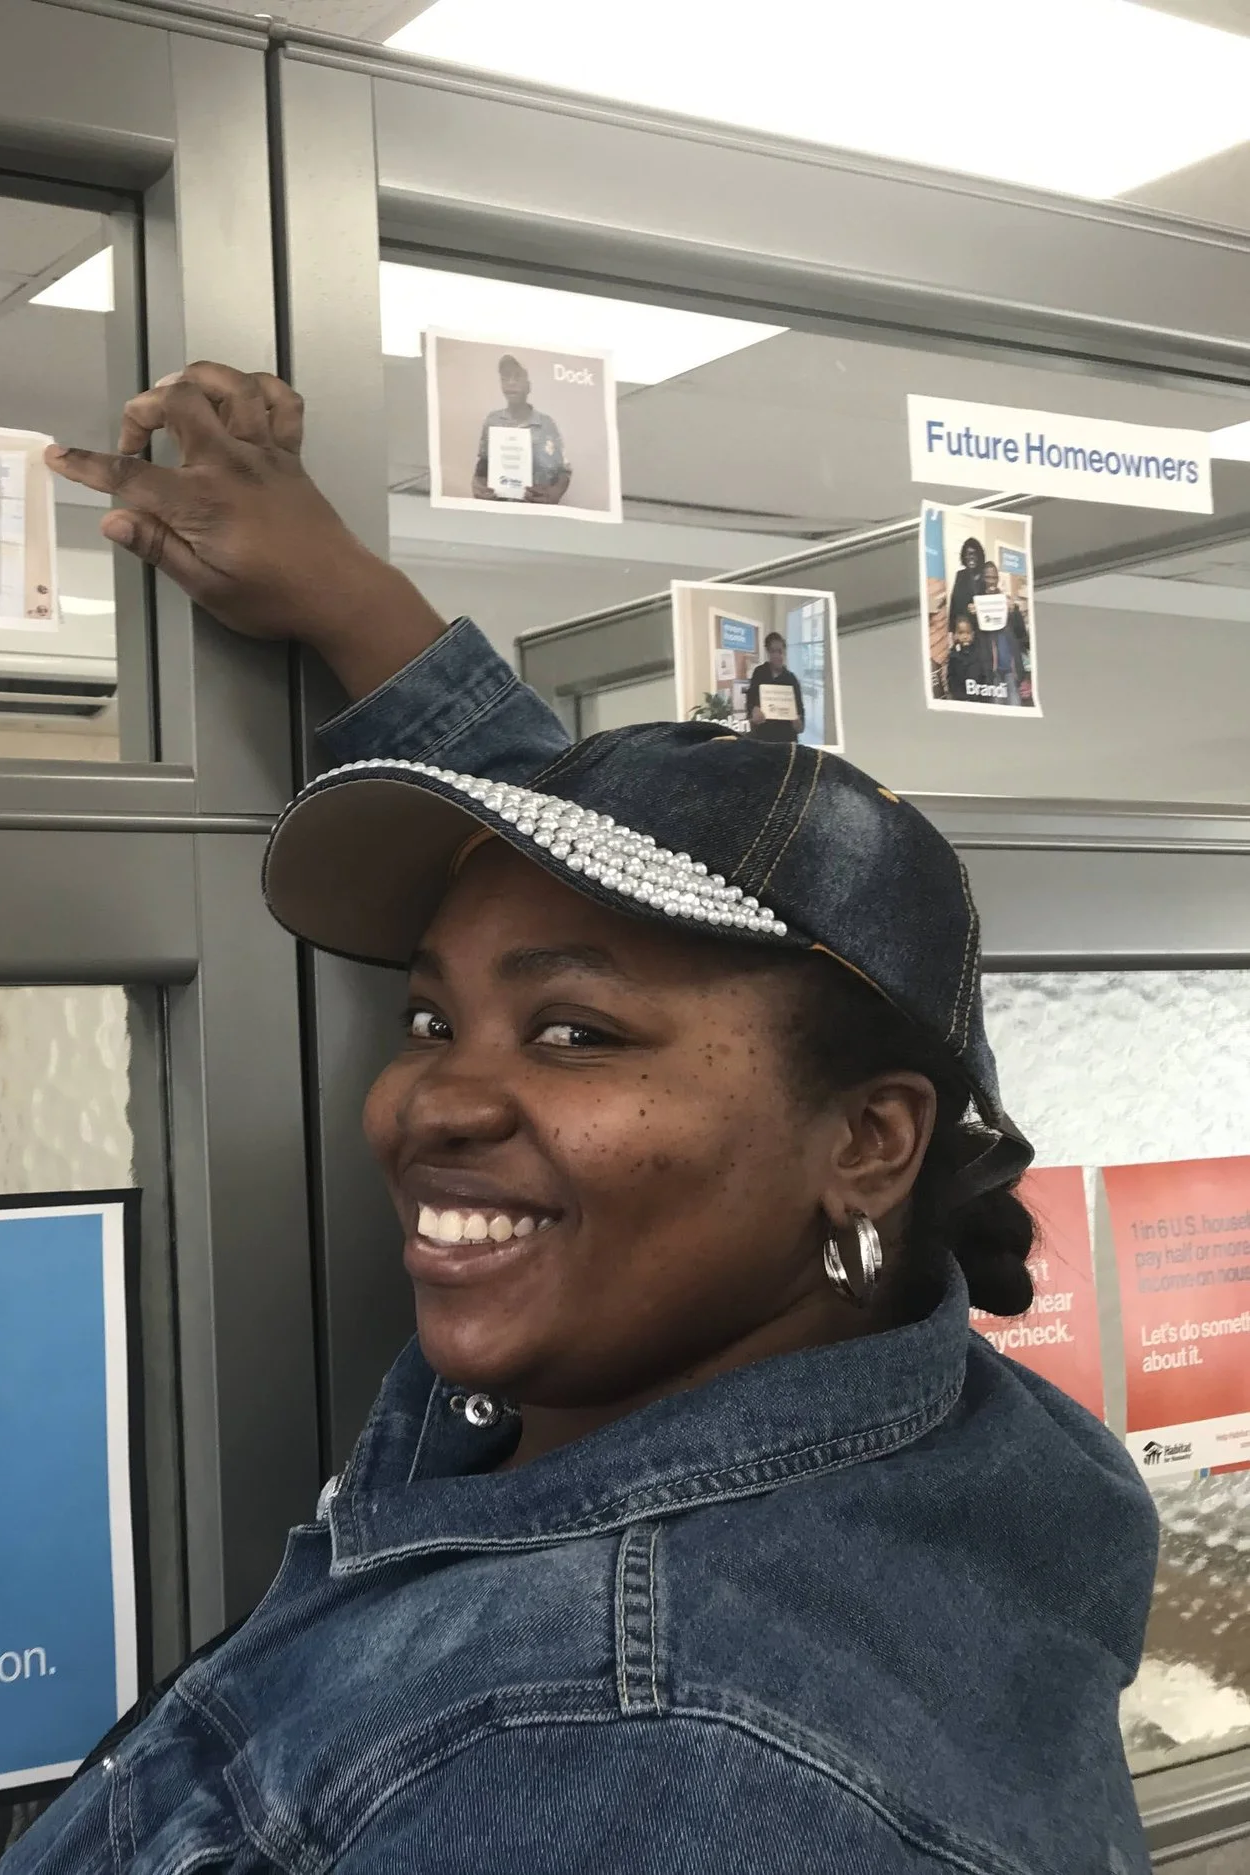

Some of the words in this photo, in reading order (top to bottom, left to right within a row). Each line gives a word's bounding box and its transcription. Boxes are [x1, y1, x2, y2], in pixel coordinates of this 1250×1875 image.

[553, 364, 594, 386] Dock
[926, 420, 1019, 463] Future
[1025, 433, 1199, 484] Homeowners
[1157, 1218, 1168, 1239] 6
[1135, 1250, 1161, 1272] pay
[984, 1318, 1075, 1354] aycheck.
[1179, 1319, 1199, 1341] do
[1142, 1348, 1187, 1373] about
[1188, 1344, 1203, 1365] it.
